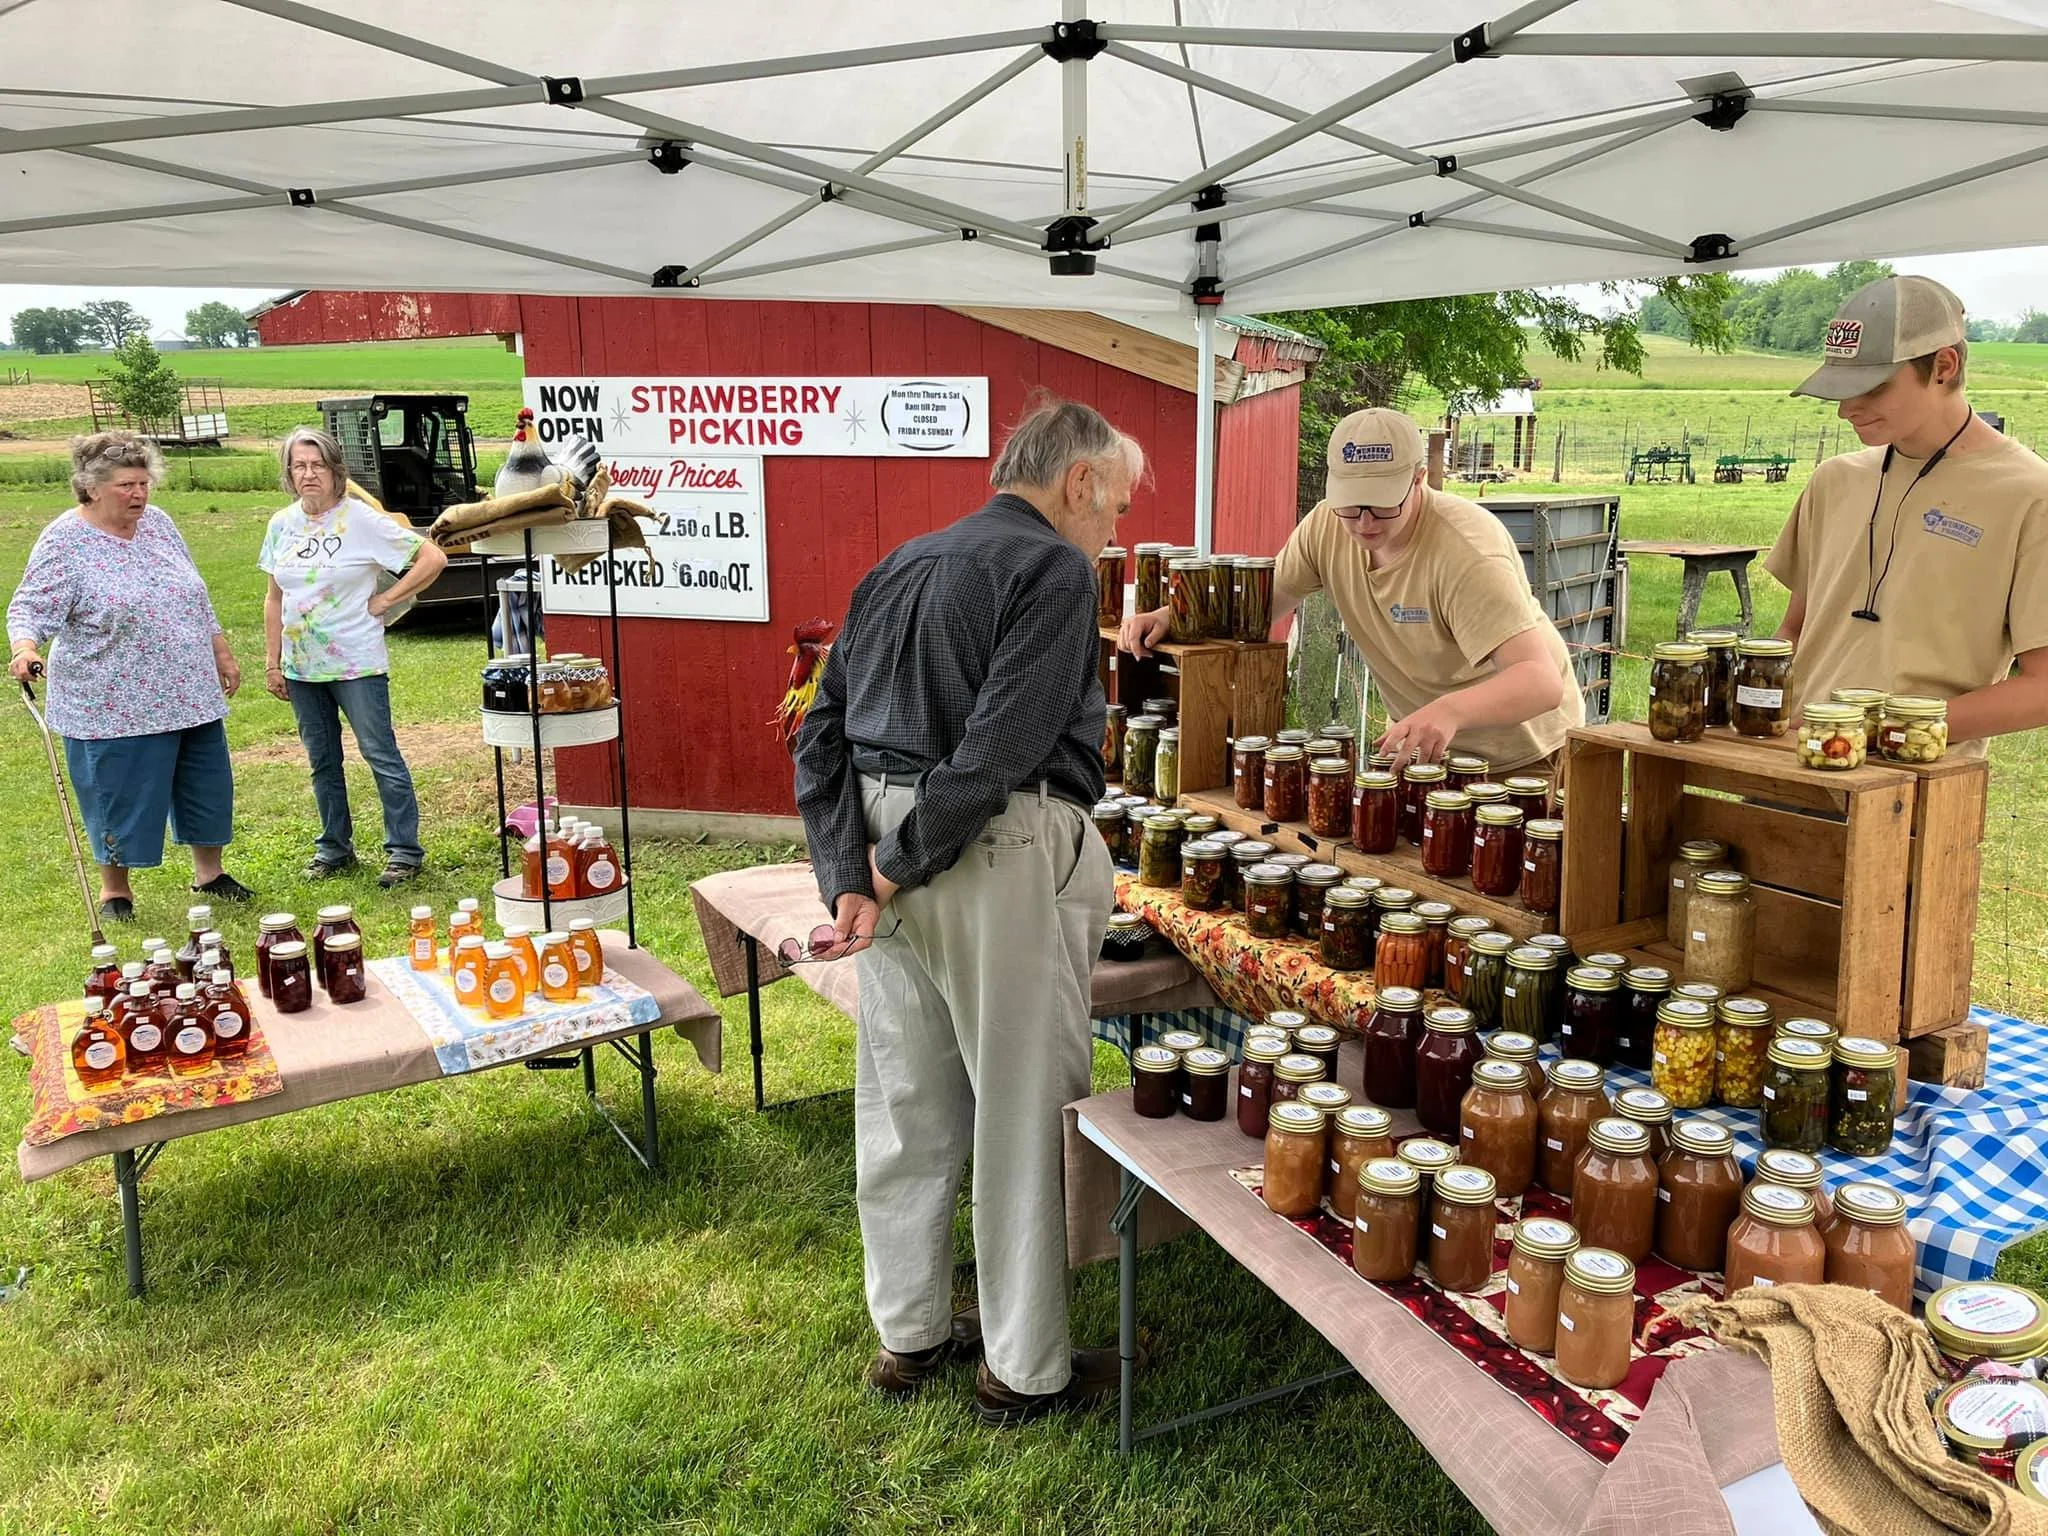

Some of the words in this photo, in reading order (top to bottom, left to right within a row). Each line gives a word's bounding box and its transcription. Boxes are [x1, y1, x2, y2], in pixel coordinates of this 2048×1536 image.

[539, 385, 599, 412] NOW
[631, 386, 842, 414] STRAWBERRY
[892, 390, 906, 398] Mon
[538, 418, 604, 443] OPEN
[669, 419, 803, 446] PICKING
[898, 427, 920, 435] FRIDAY
[927, 428, 953, 436] SUNDAY
[668, 460, 742, 488] Prices
[702, 524, 710, 537] a
[715, 512, 749, 538] LB.
[728, 562, 753, 593] QT.
